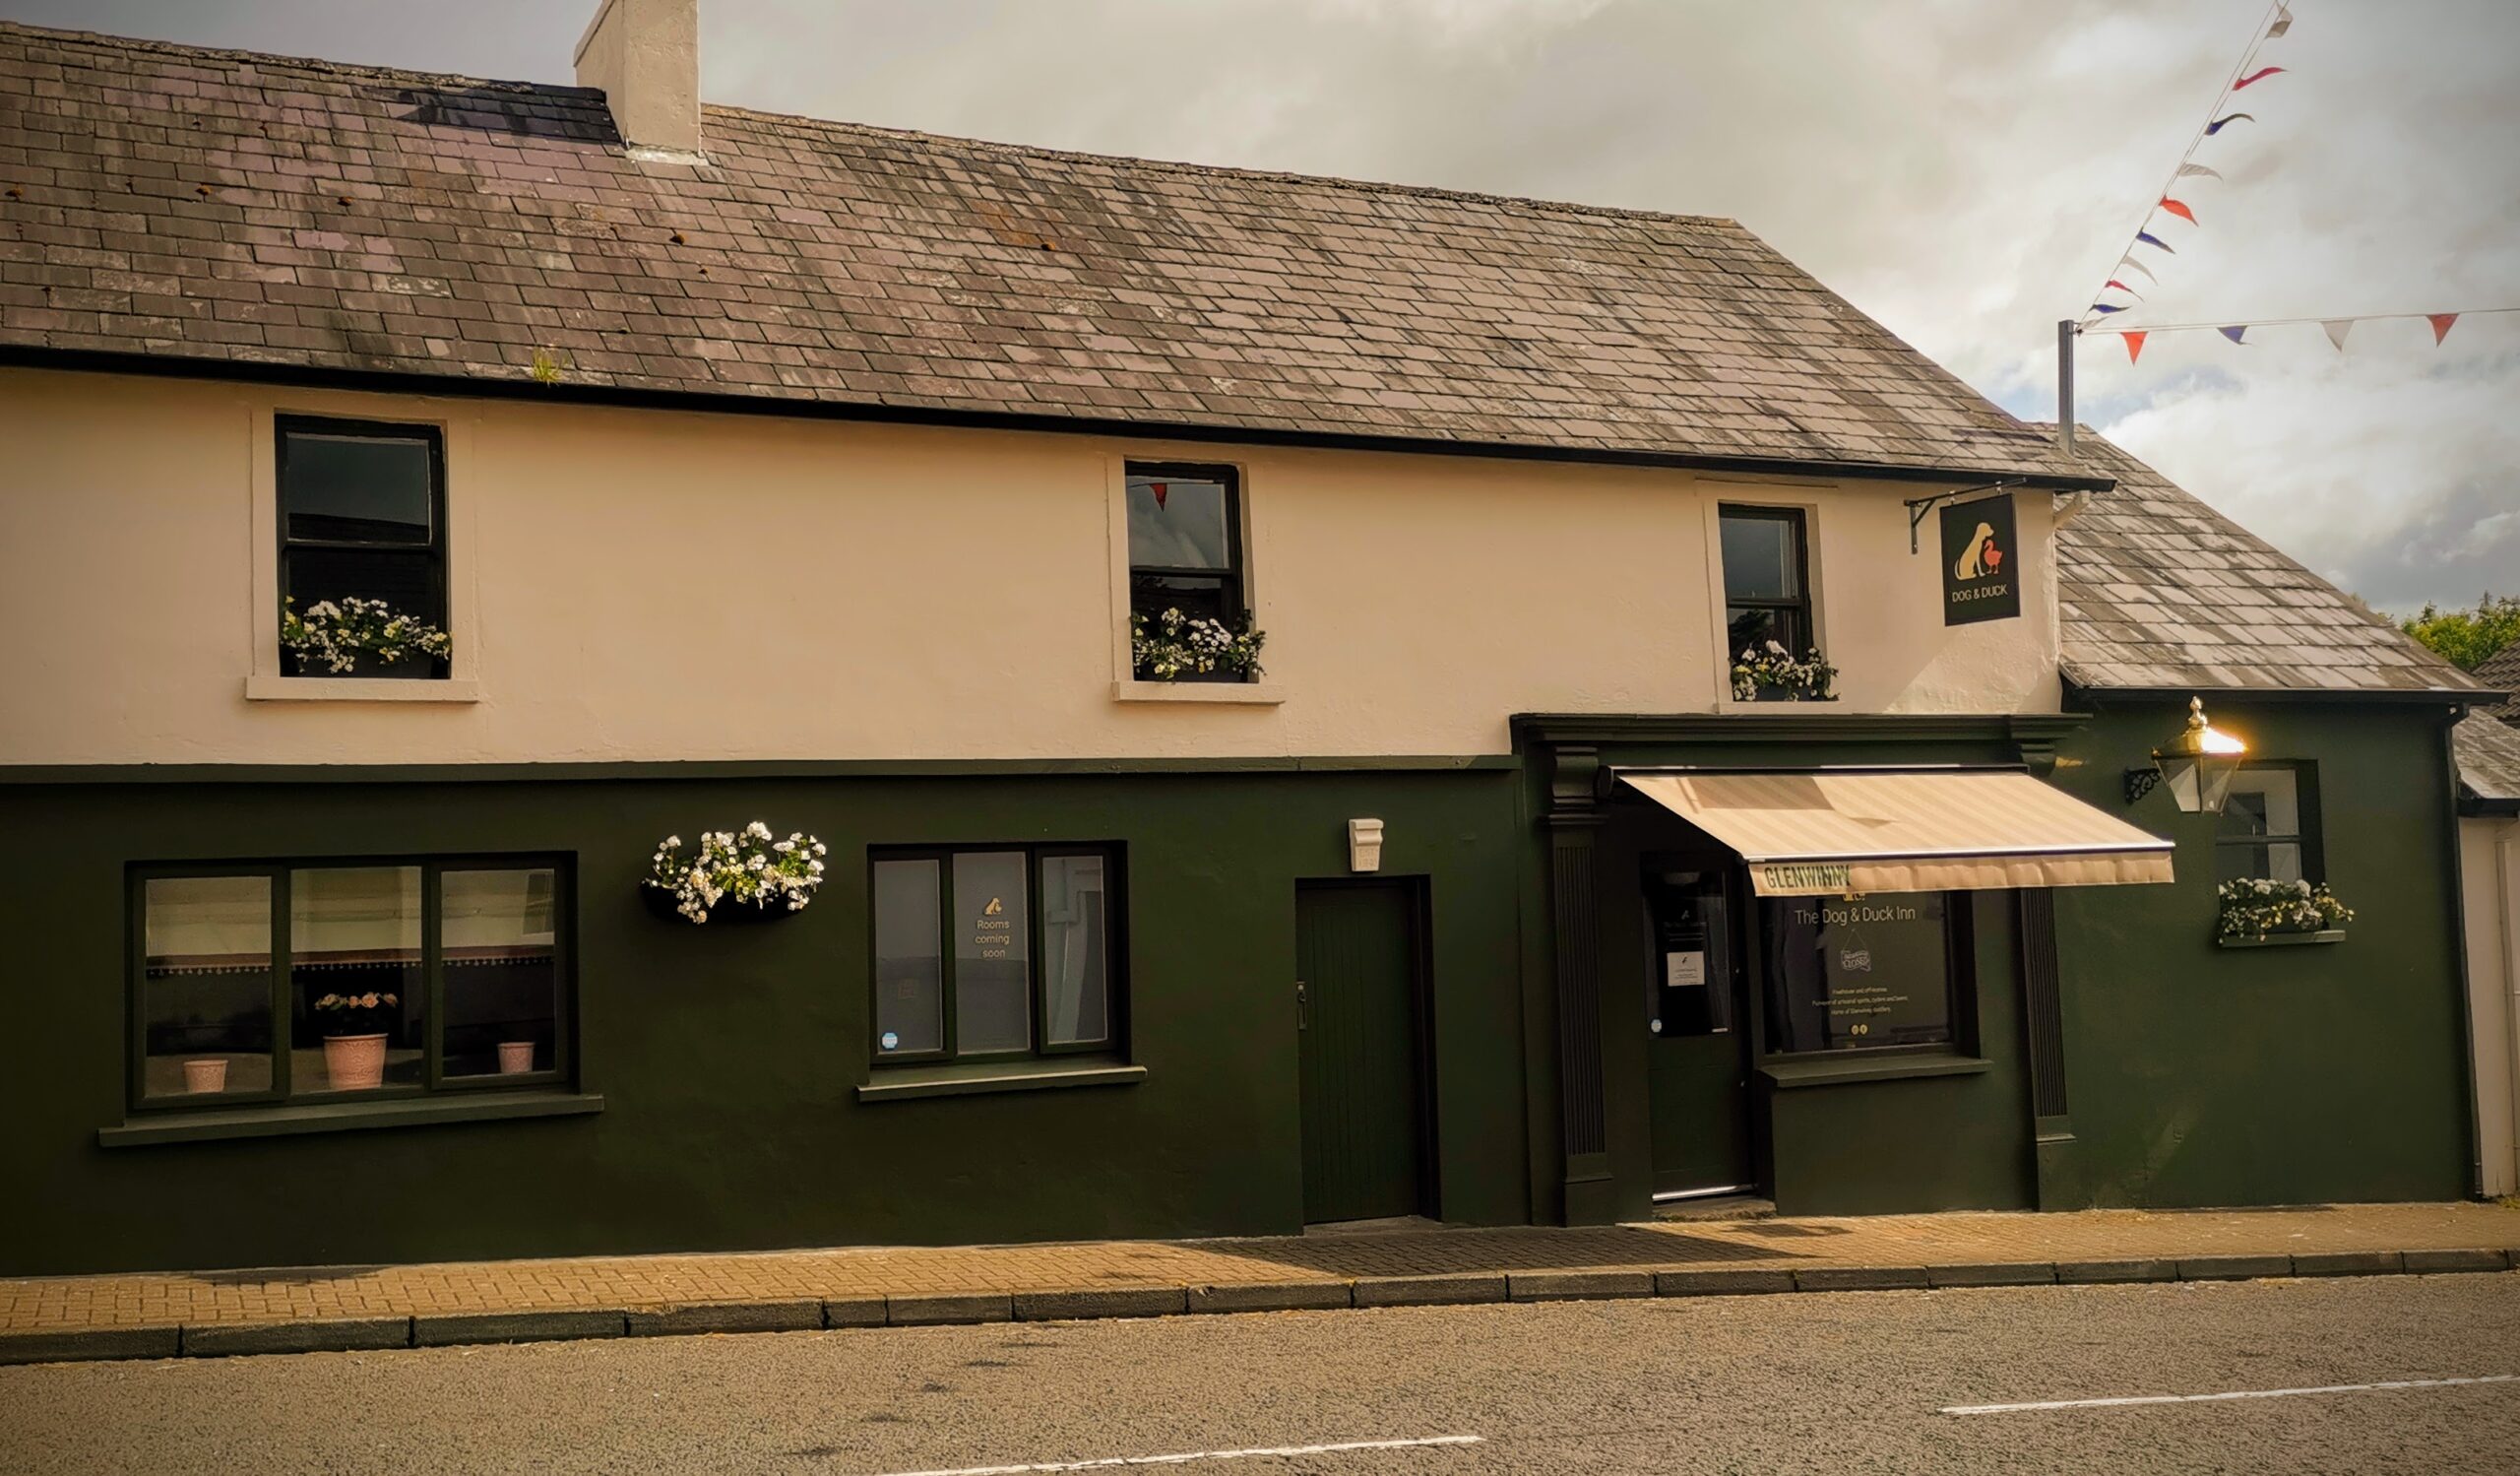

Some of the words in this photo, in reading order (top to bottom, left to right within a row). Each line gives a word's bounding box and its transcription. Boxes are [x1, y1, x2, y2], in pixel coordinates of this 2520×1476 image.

[1952, 590, 1972, 603] DOG
[1974, 588, 1980, 600] &
[1982, 584, 2008, 598] DUCK
[1764, 865, 1851, 888] GLENWINNY
[1795, 909, 1819, 925] The
[1822, 908, 1848, 926] Dog
[1851, 907, 1859, 922] &
[1862, 906, 1894, 922] Duck
[1896, 906, 1916, 920] Inn
[976, 920, 1010, 930] Rooms
[975, 934, 1010, 945] coming
[982, 949, 1006, 958] soon
